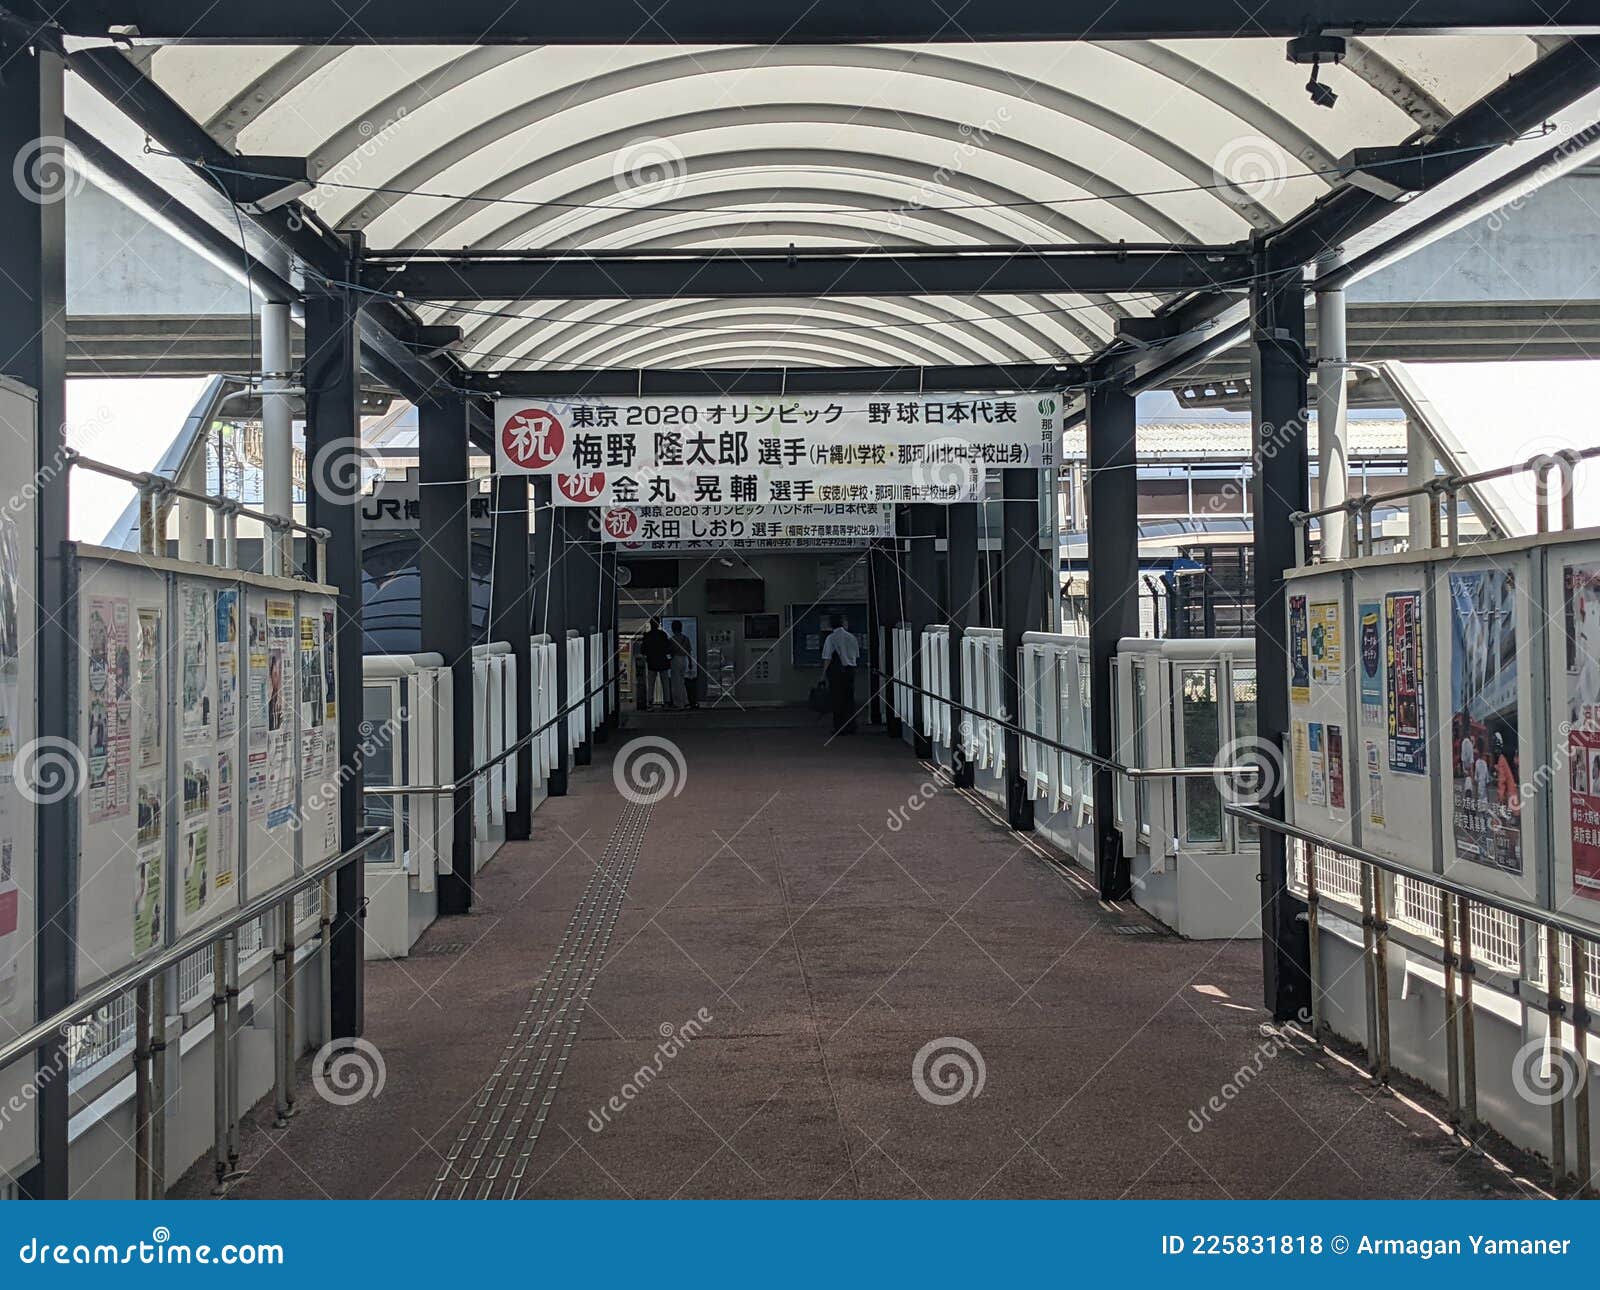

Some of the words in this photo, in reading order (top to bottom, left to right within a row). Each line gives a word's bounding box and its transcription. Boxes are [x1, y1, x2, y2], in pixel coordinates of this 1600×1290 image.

[572, 405, 619, 428] 東京
[626, 405, 698, 425] 2020
[706, 403, 844, 425] オリンピック
[868, 401, 1017, 425] 野球日本代表
[508, 415, 557, 462] 祝
[572, 432, 637, 470] 梅野
[653, 431, 749, 467] 隆太郎
[758, 438, 807, 466] 選手
[1040, 418, 1053, 466] 那珂川市
[562, 472, 604, 498] 祝
[611, 475, 676, 503] 金丸
[694, 475, 758, 502] 晃輔
[769, 480, 815, 502] 選手
[607, 510, 634, 536] 祝
[665, 506, 699, 517] 2020
[641, 520, 681, 539] 永田
[691, 519, 745, 538] しおり
[752, 522, 782, 537] 選手
